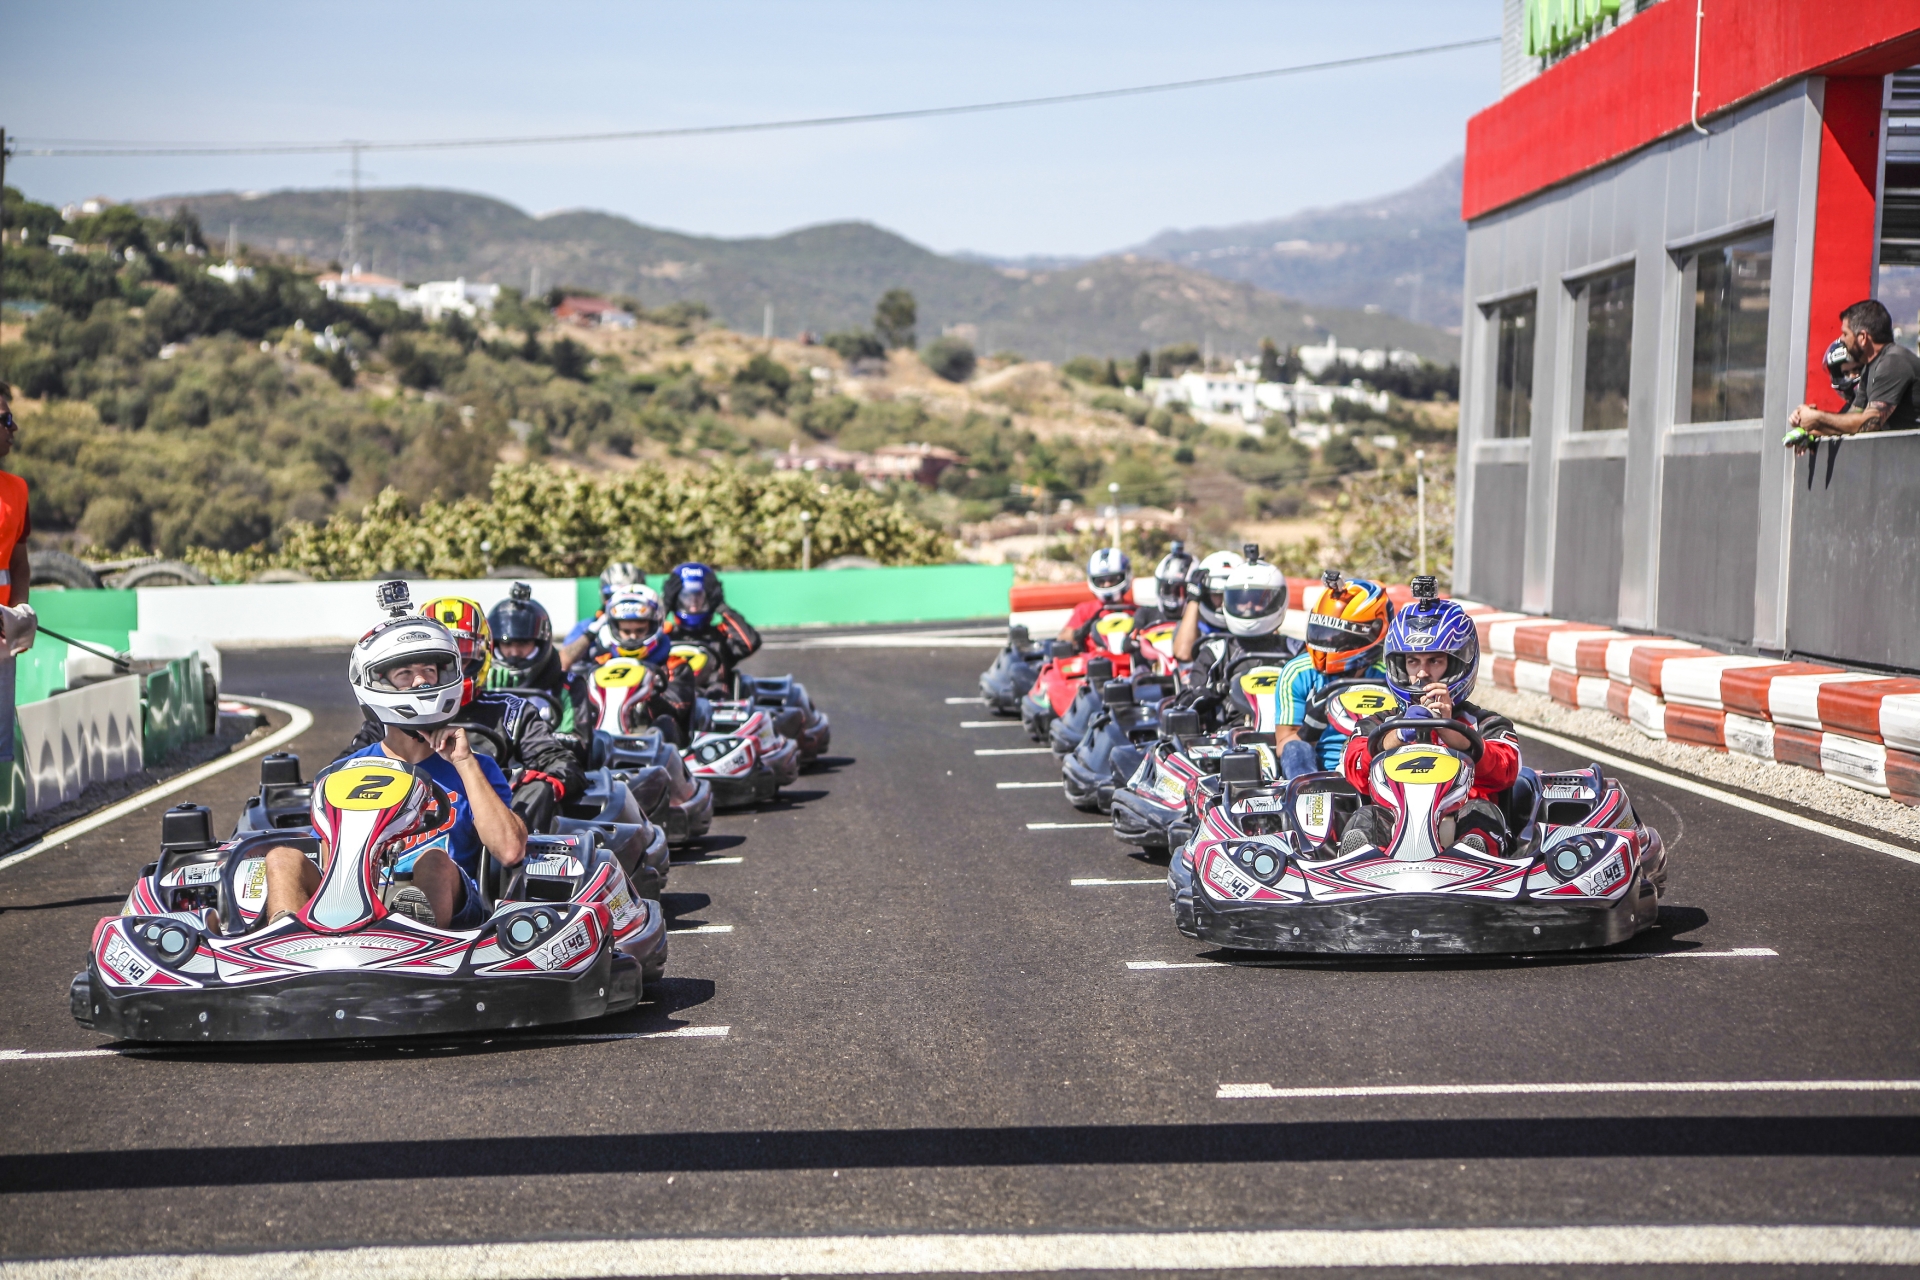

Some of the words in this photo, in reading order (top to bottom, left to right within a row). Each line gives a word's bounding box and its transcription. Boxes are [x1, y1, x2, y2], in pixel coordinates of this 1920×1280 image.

[1309, 612, 1348, 630] RENAULT
[1395, 756, 1438, 774] 4
[346, 775, 395, 800] 2
